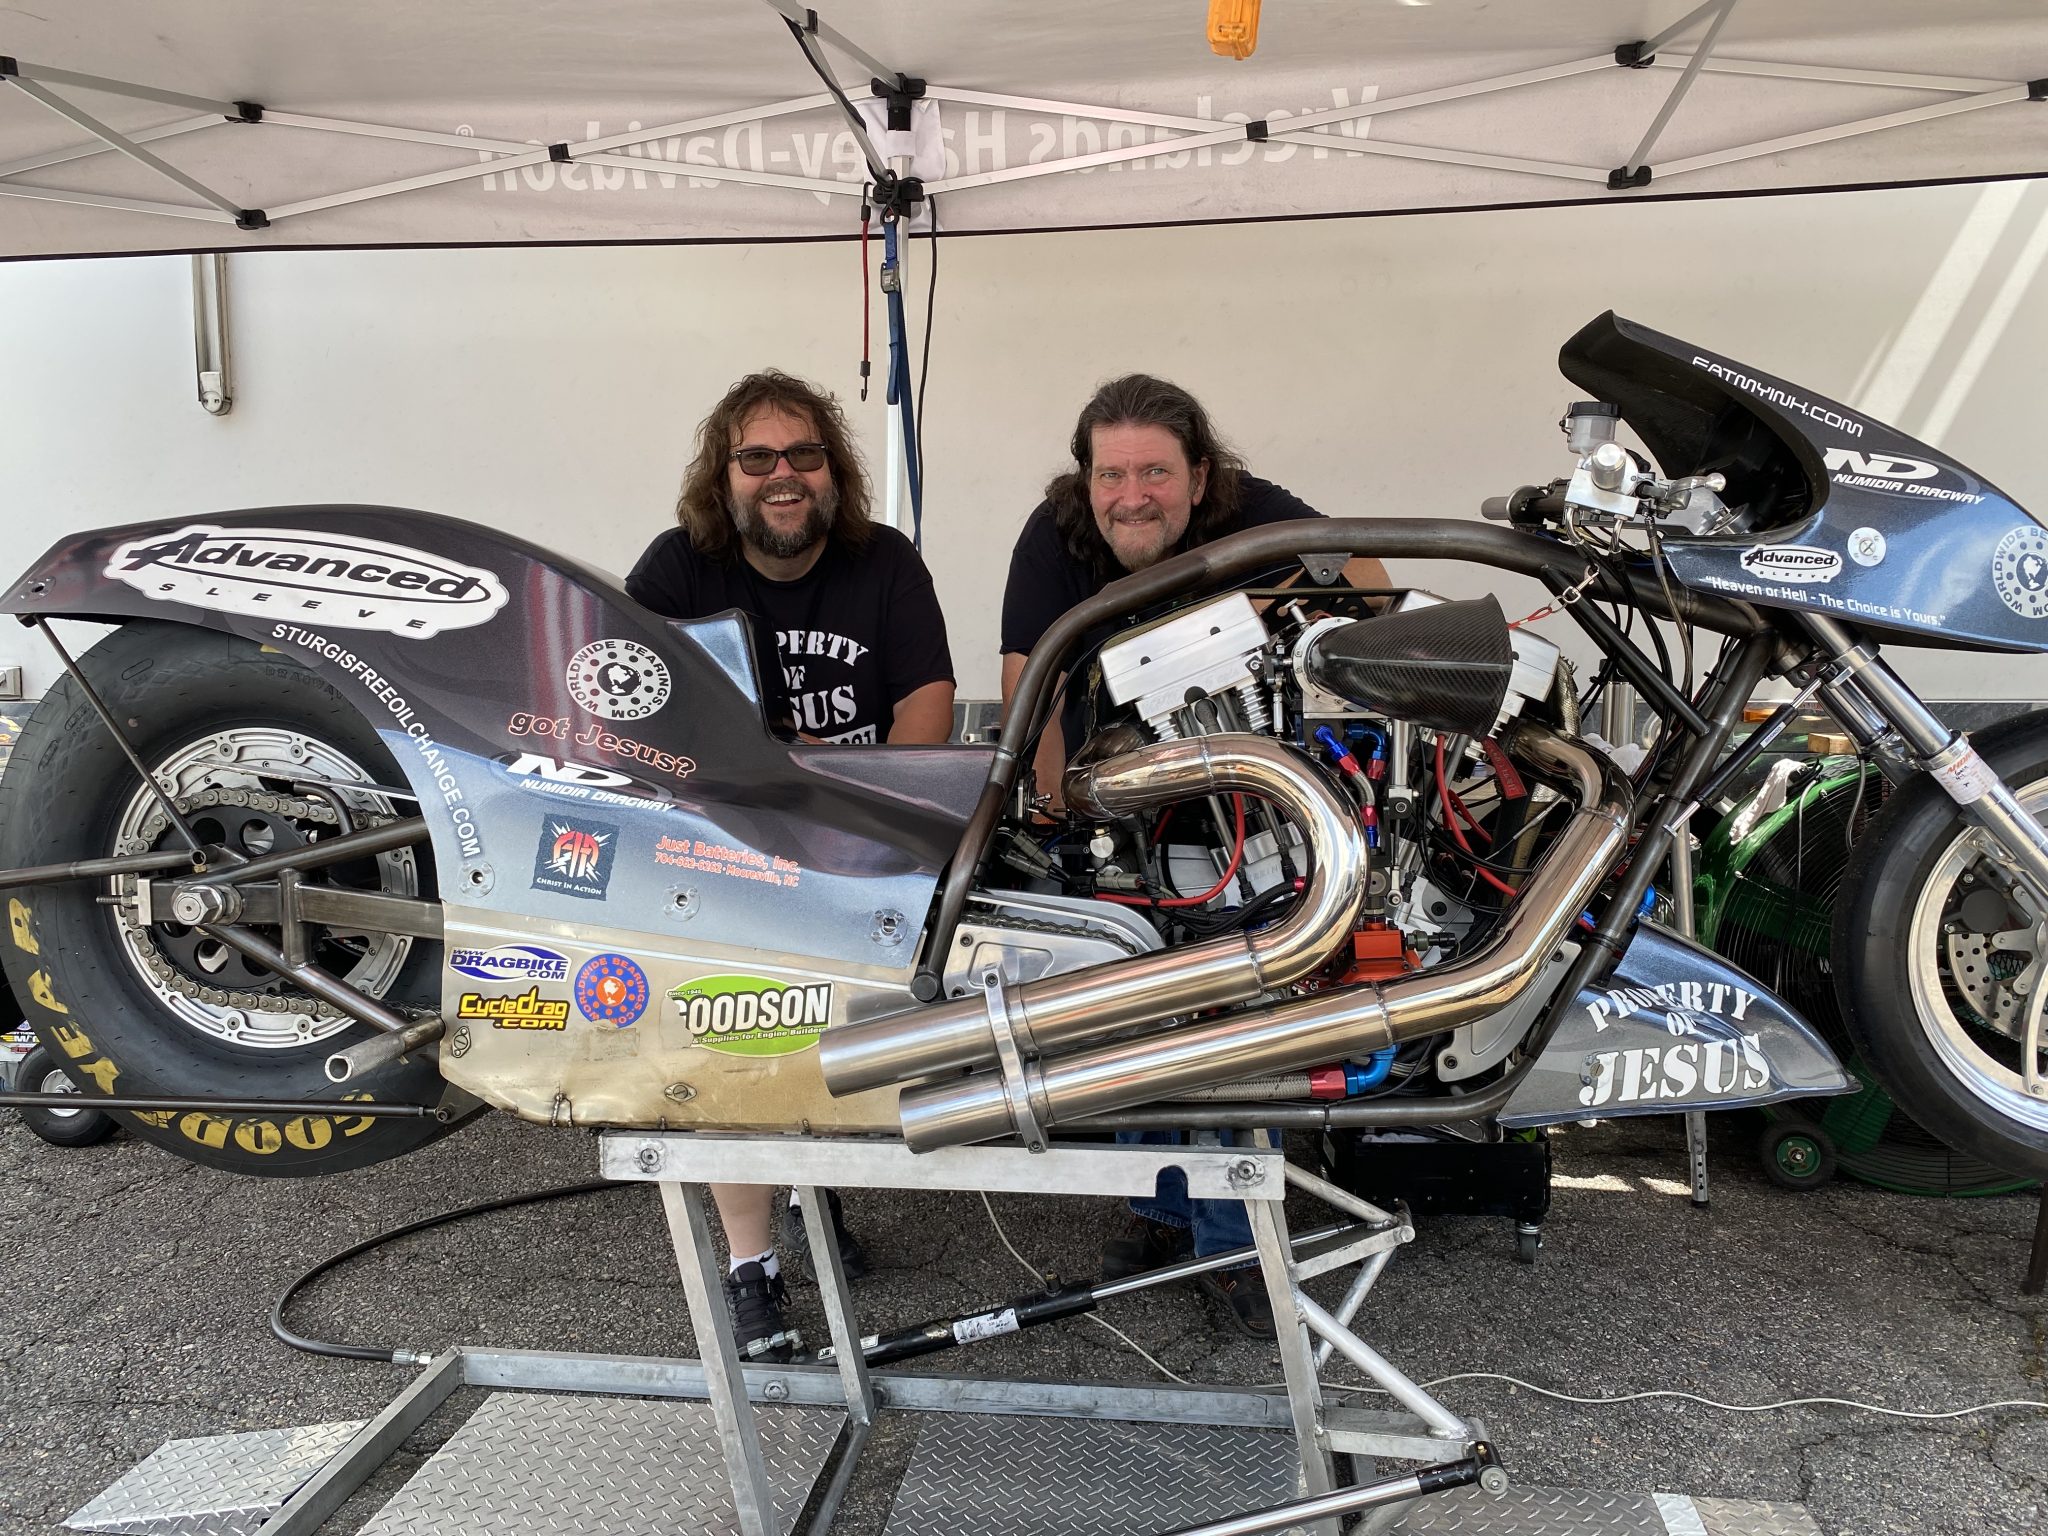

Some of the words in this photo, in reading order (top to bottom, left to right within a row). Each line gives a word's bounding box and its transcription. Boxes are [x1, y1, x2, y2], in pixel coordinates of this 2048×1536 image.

[1692, 355, 1864, 438] FATMYINK.COM
[1833, 473, 1903, 491] NUMIDIA
[1905, 484, 1986, 505] DRAGWAY
[120, 532, 483, 600] Advanced
[1744, 547, 1835, 567] Advanced
[1759, 570, 1829, 580] SLEEVE
[159, 582, 426, 630] SLEEVE
[1766, 586, 1778, 598] or
[1782, 586, 1808, 602] Hell
[1818, 593, 1845, 609] The
[1847, 598, 1889, 617] Choice
[1890, 605, 1901, 619] is
[569, 641, 617, 713] WORLDWIDE
[611, 642, 670, 719] BEARINGS.COM
[272, 623, 481, 858] STURGISFREEOILCHANGE.COM
[508, 712, 571, 739] got
[576, 724, 697, 779] Jesus?
[519, 778, 590, 798] NUMIDIA
[591, 790, 676, 812] DRAGWAY
[655, 835, 690, 854] Just
[450, 954, 569, 971] DRAGBIKE
[1585, 981, 1758, 1033] PROPERTY
[702, 1034, 740, 1045] Supplies
[742, 1032, 756, 1041] for
[757, 1030, 788, 1040] Engine
[1666, 1012, 1698, 1037] OF
[1578, 1032, 1771, 1107] JESUS
